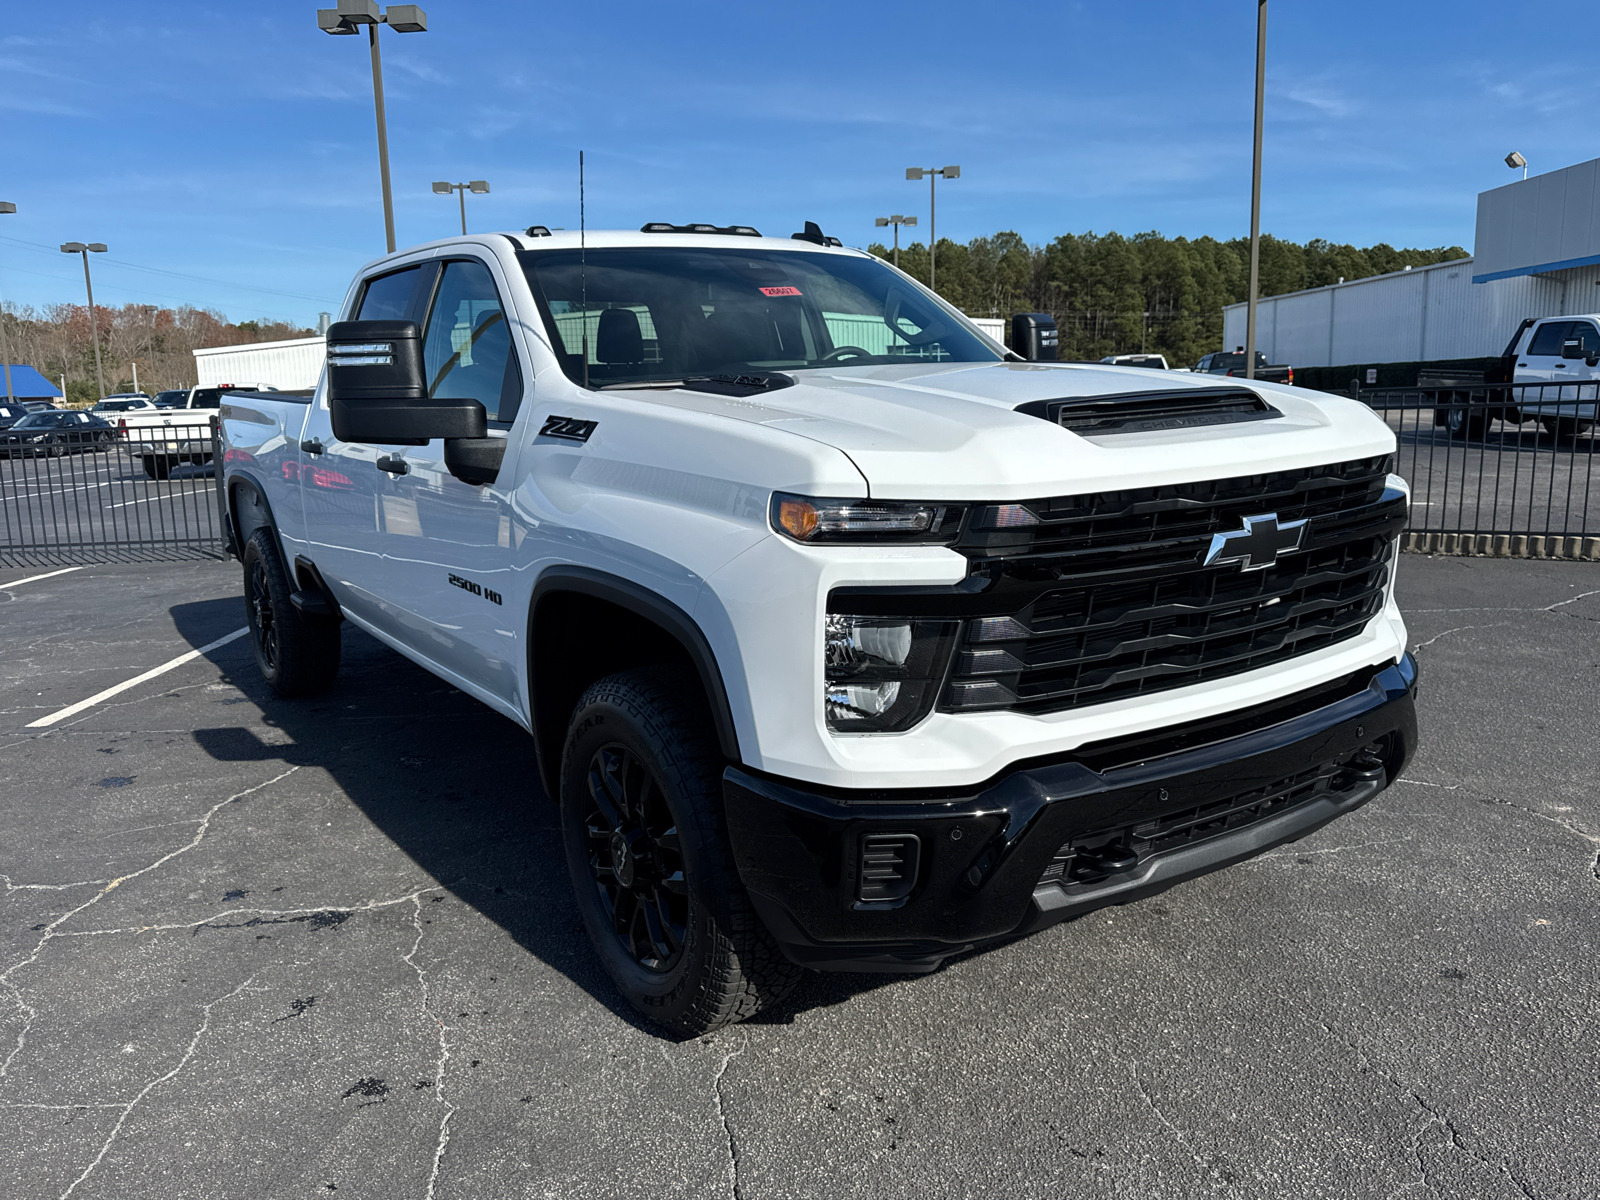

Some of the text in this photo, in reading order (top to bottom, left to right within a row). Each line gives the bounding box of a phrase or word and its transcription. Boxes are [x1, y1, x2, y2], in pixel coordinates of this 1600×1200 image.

[538, 414, 599, 443] Z71
[1140, 414, 1234, 430] CHEVROLET
[448, 572, 502, 606] 2500 HD
